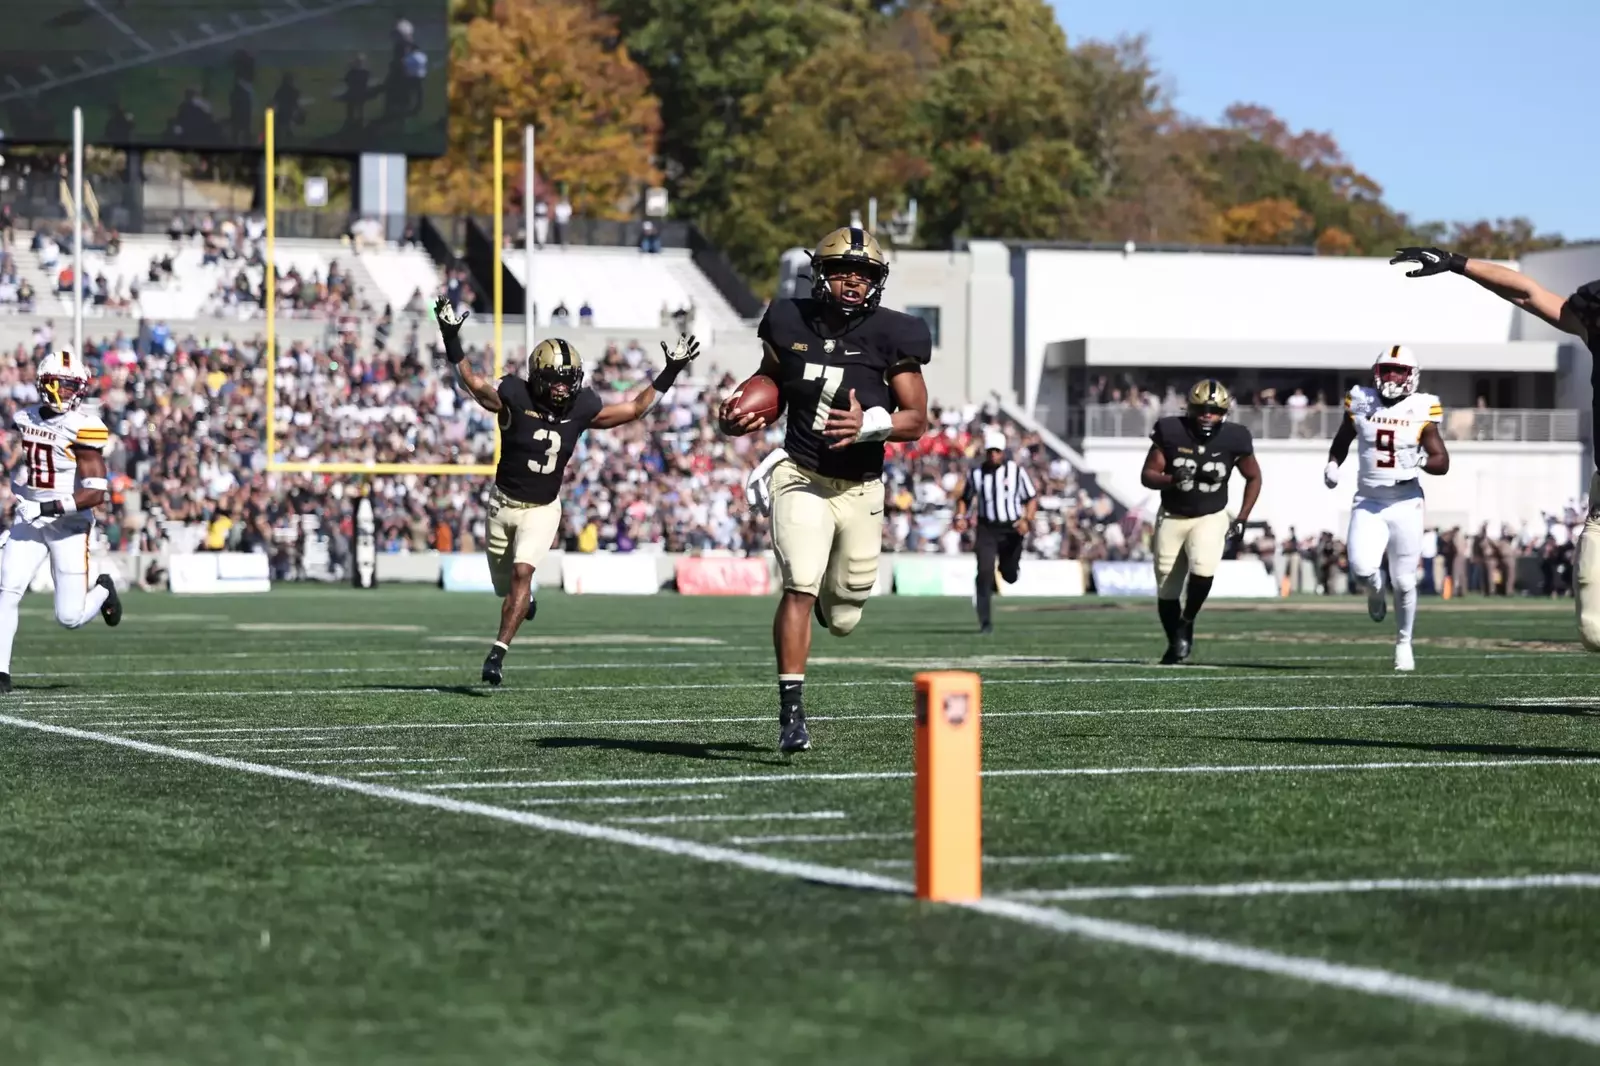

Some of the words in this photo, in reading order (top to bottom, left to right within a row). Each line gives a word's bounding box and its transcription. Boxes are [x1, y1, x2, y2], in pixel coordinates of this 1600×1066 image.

[803, 362, 844, 431] 7
[527, 429, 561, 474] 3
[1376, 429, 1395, 468] 9
